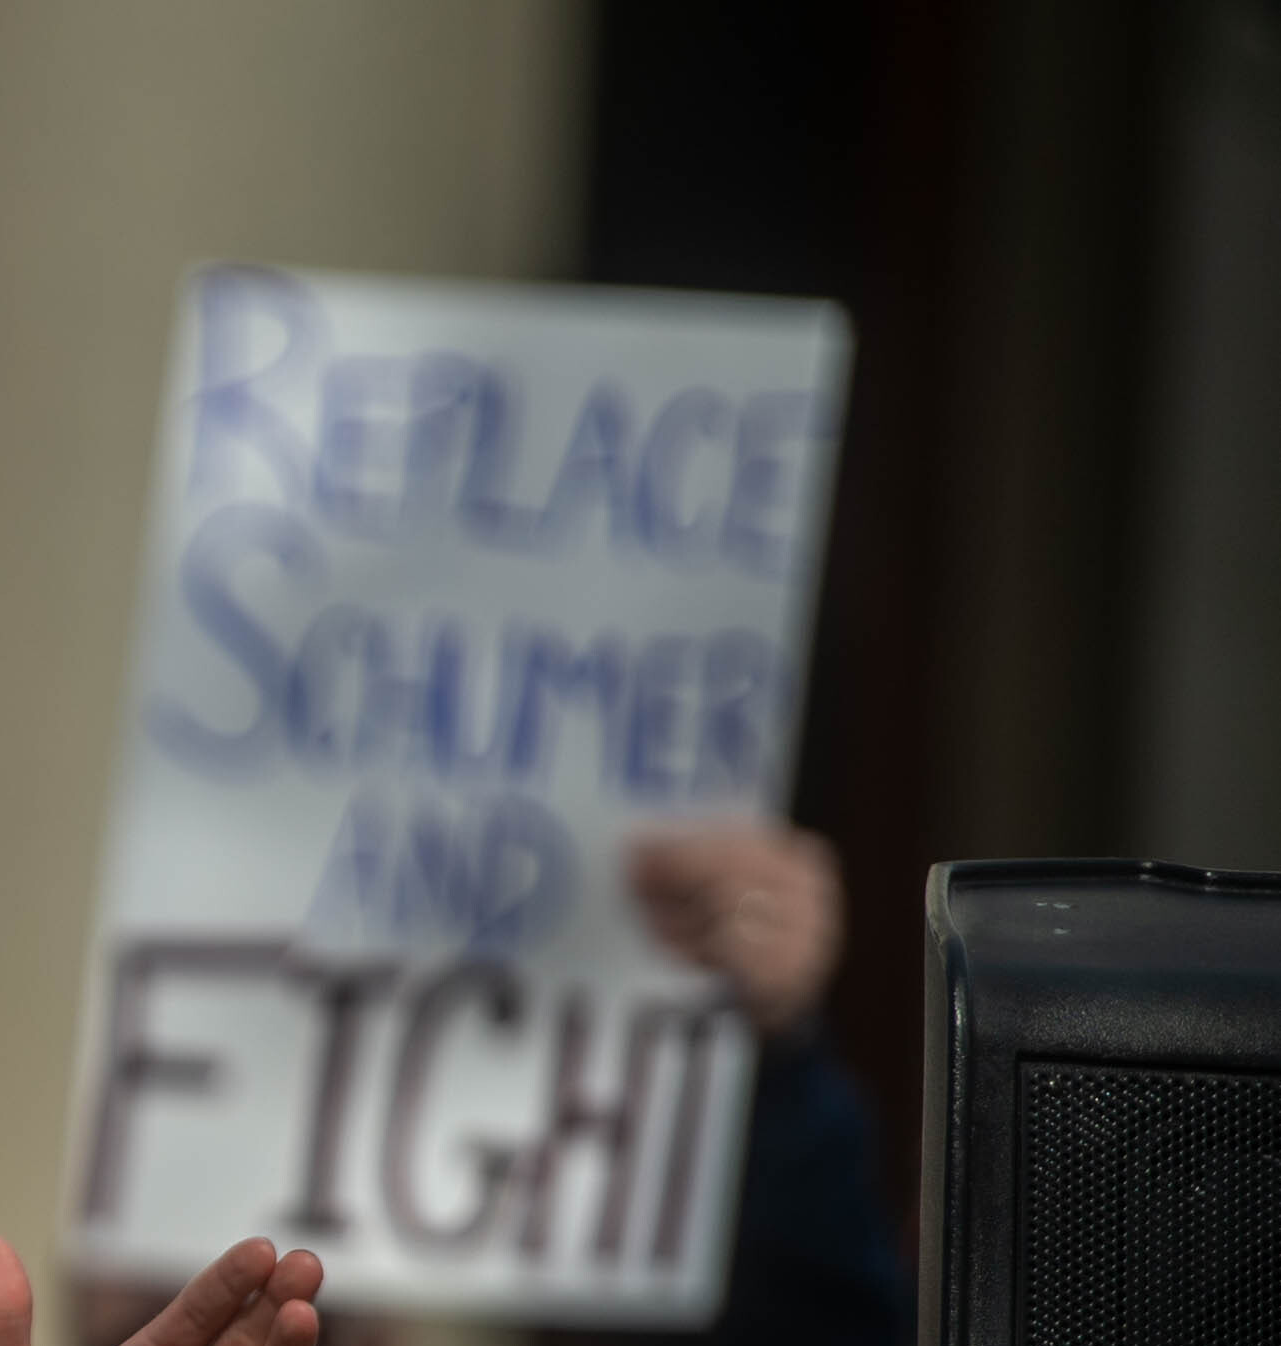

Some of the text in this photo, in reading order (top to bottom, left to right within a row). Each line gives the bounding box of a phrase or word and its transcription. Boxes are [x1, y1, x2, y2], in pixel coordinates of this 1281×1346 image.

[186, 262, 834, 580] REPLACE
[144, 502, 789, 800] SCHUMER
[303, 786, 584, 950] AND
[77, 926, 754, 1275] FIGHT
